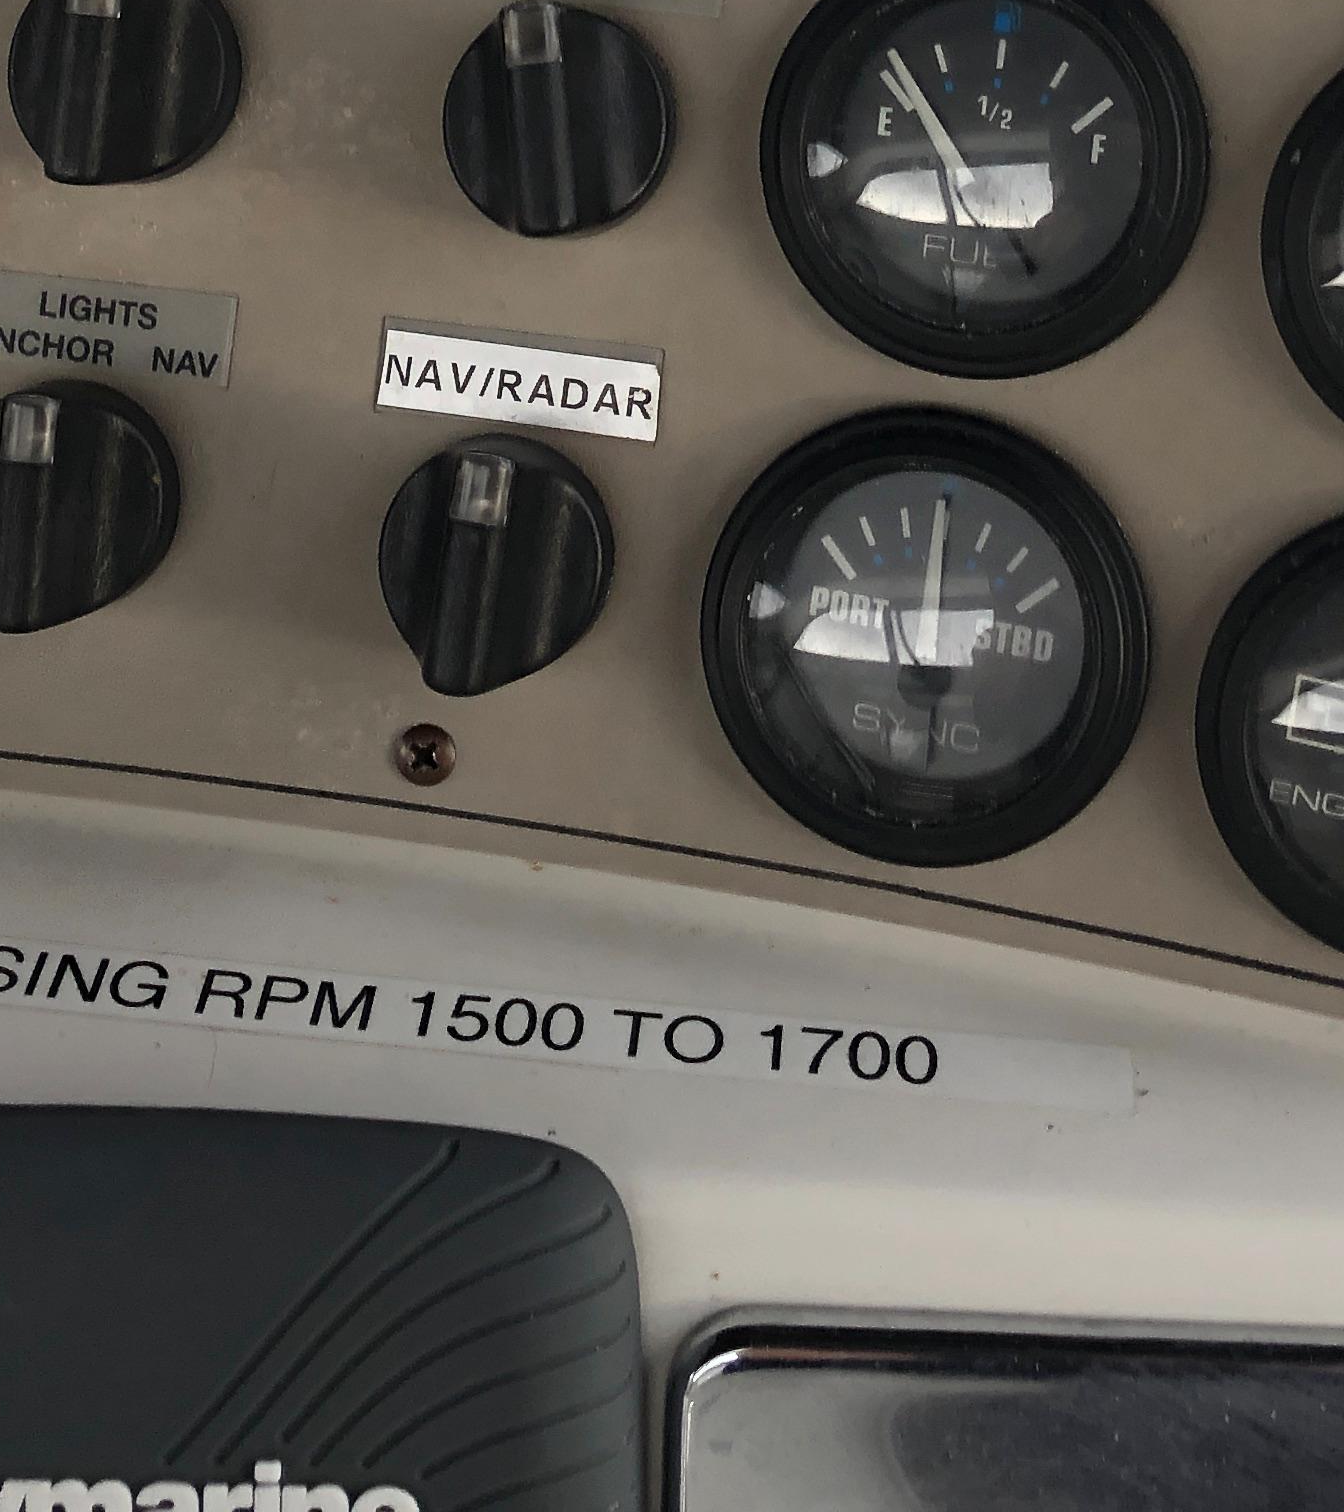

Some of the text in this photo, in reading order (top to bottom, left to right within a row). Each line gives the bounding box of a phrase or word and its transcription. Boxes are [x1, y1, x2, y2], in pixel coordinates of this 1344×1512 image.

[877, 106, 893, 137] E
[977, 94, 1013, 131] 1/2
[1090, 133, 1107, 165] F
[39, 291, 158, 331] LIGHTS
[150, 344, 219, 380] NAV
[384, 353, 654, 422] NAV/RADAR
[808, 585, 890, 629] PORT
[974, 617, 1055, 663] STBD
[194, 968, 378, 1034] RPM
[409, 990, 586, 1054] 1500
[613, 1008, 725, 1065] TO
[759, 1023, 940, 1087] 1700
